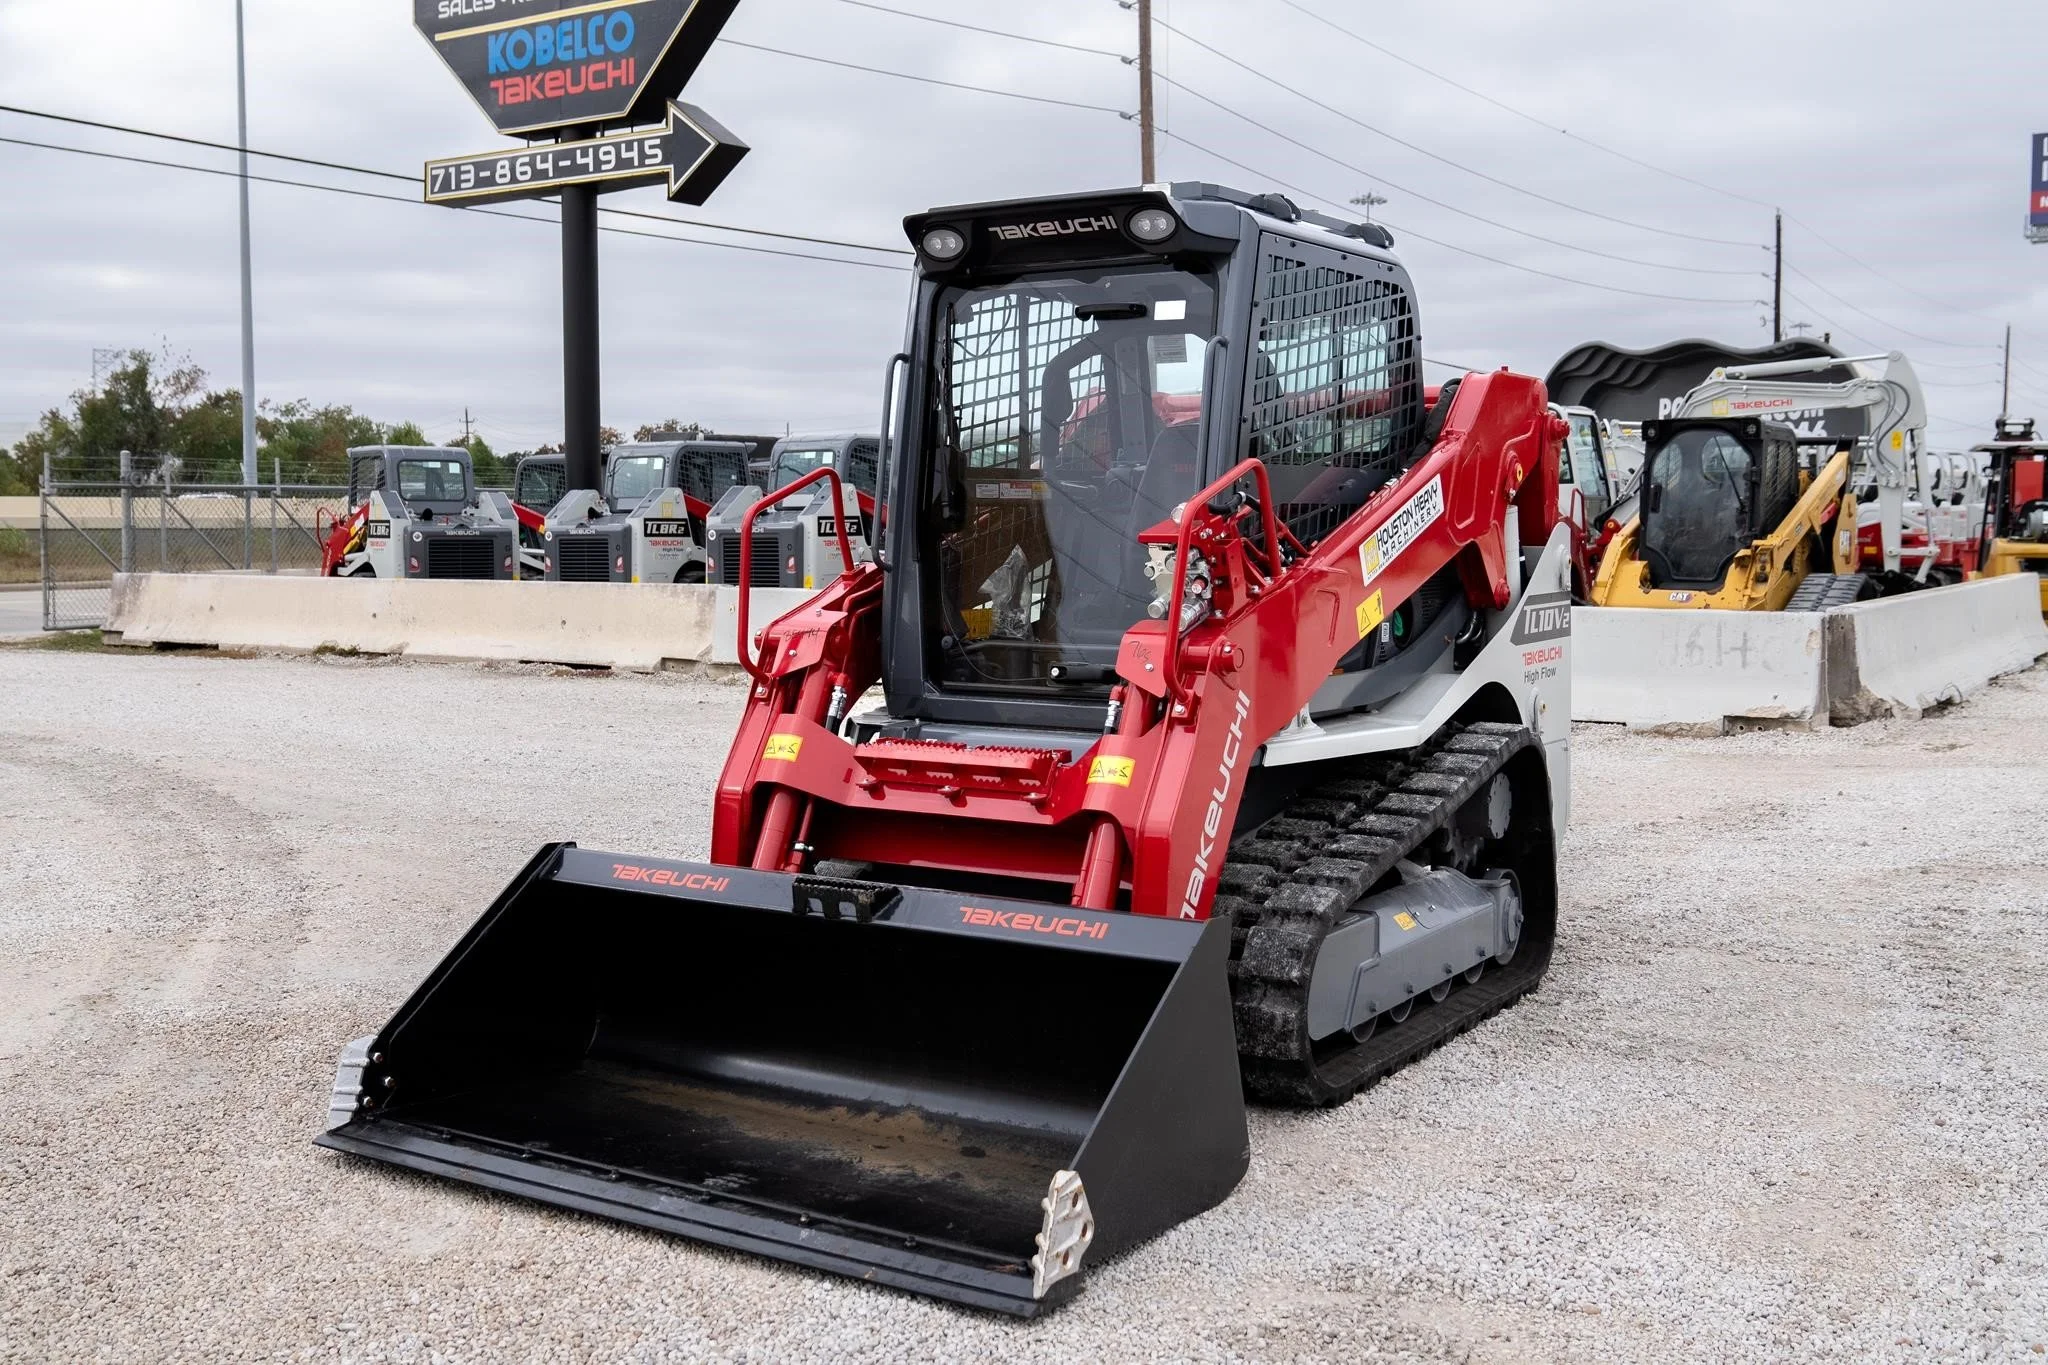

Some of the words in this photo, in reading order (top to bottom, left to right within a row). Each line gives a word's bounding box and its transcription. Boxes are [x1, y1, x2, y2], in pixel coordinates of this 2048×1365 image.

[438, 0, 496, 19] SALES
[487, 10, 635, 74] KOBELCO
[430, 138, 663, 193] 713-864-4945
[1376, 505, 1413, 552] HOUSTON
[1413, 481, 1438, 514] HEAVY
[1382, 502, 1438, 559] MACHINERY
[1669, 591, 1690, 601] CAT
[1523, 670, 1540, 684] High
[1541, 666, 1557, 680] Flow
